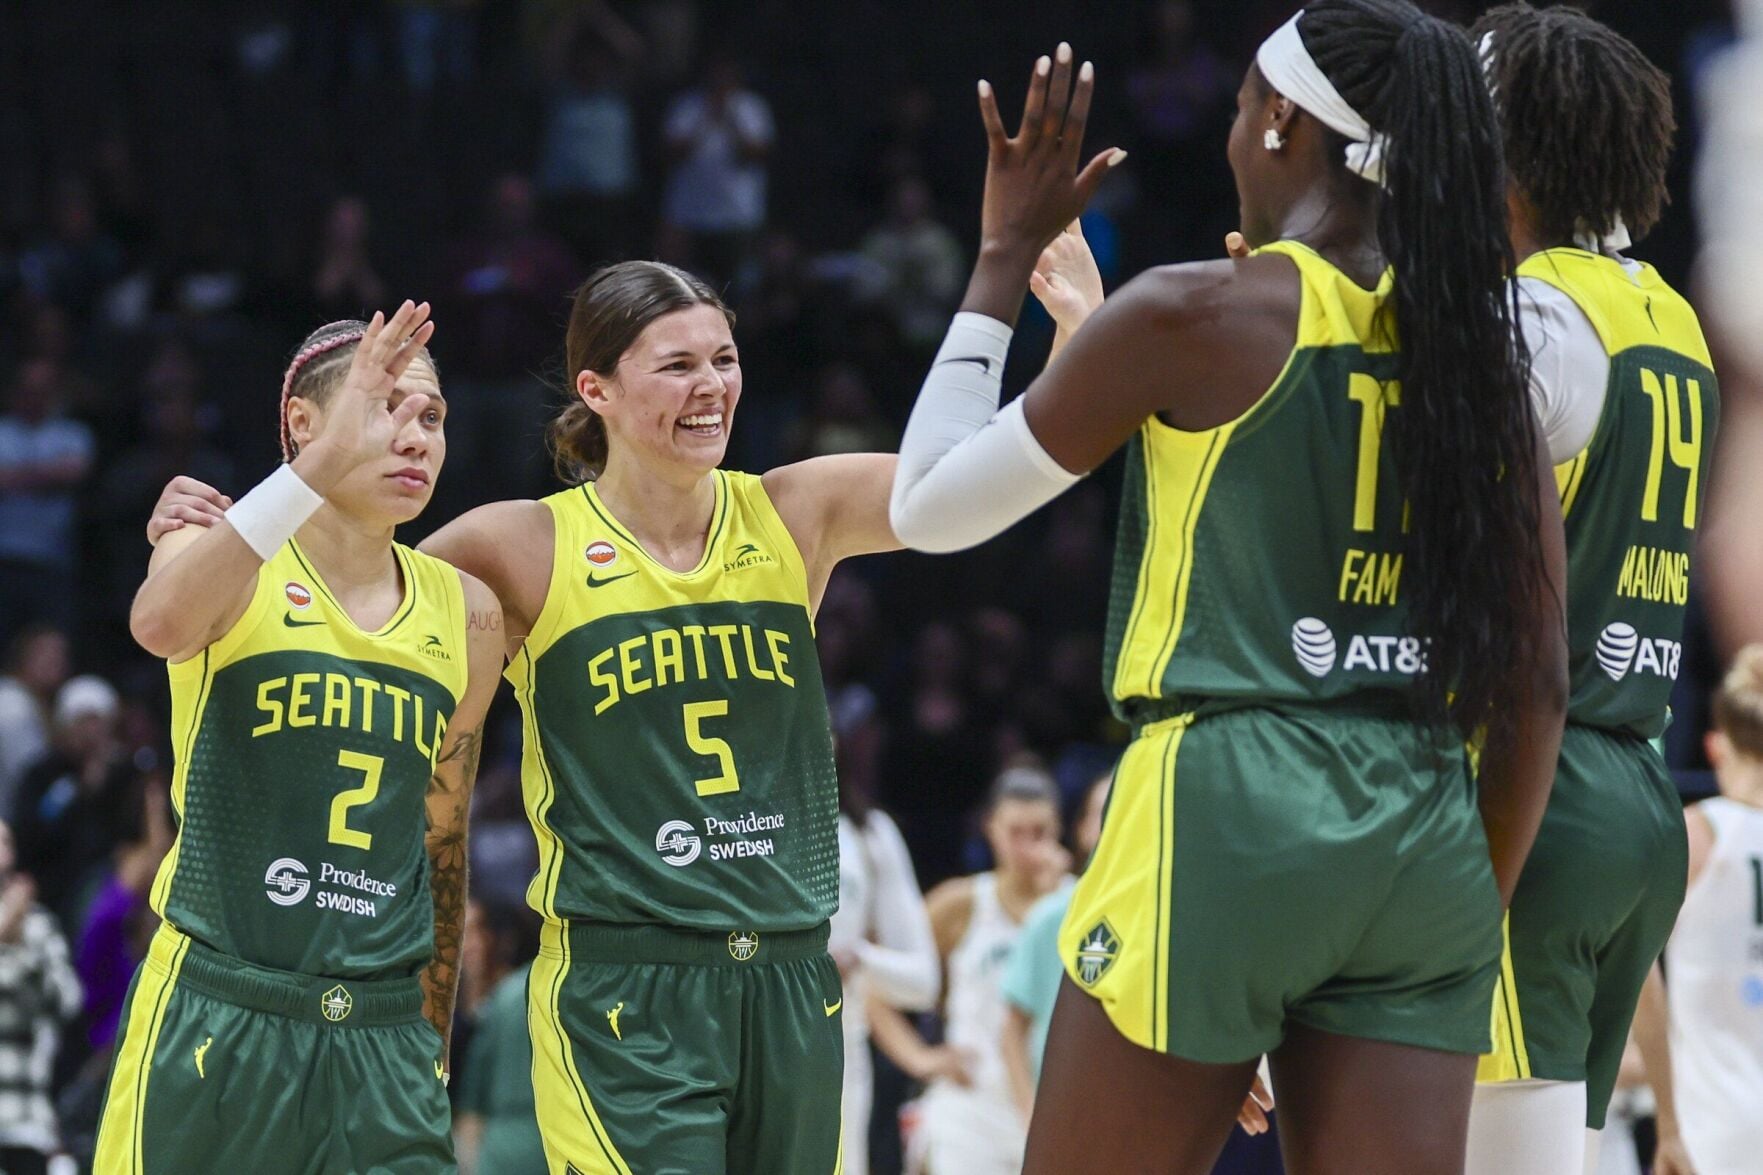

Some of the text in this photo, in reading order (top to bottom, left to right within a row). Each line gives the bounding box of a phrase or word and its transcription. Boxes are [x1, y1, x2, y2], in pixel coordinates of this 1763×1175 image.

[1640, 367, 1702, 529] 14
[723, 555, 773, 572] SYMETRA
[1338, 548, 1403, 606] FAM
[416, 644, 451, 661] SYMETRA
[588, 624, 795, 716] SEATTLE
[1343, 634, 1431, 674] AT&
[683, 699, 740, 797] 5
[327, 749, 385, 851] 2
[703, 810, 785, 836] Providence
